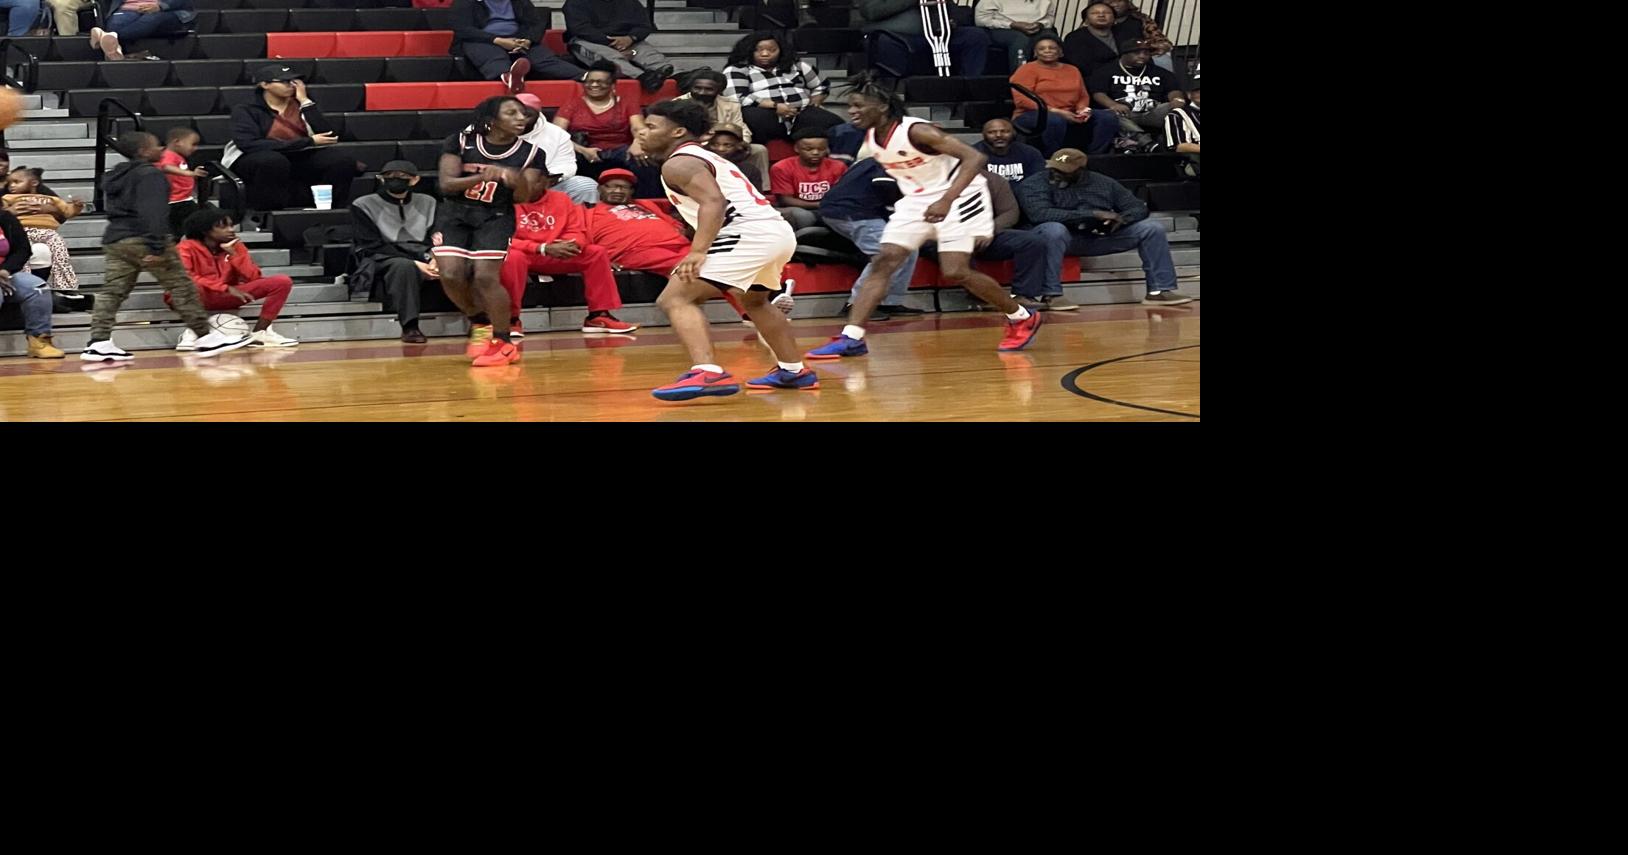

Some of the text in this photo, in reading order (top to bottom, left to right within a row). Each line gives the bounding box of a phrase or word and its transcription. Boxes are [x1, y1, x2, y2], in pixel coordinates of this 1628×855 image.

[1112, 75, 1161, 86] TUPAC
[464, 180, 498, 203] 21
[799, 181, 830, 194] UCS
